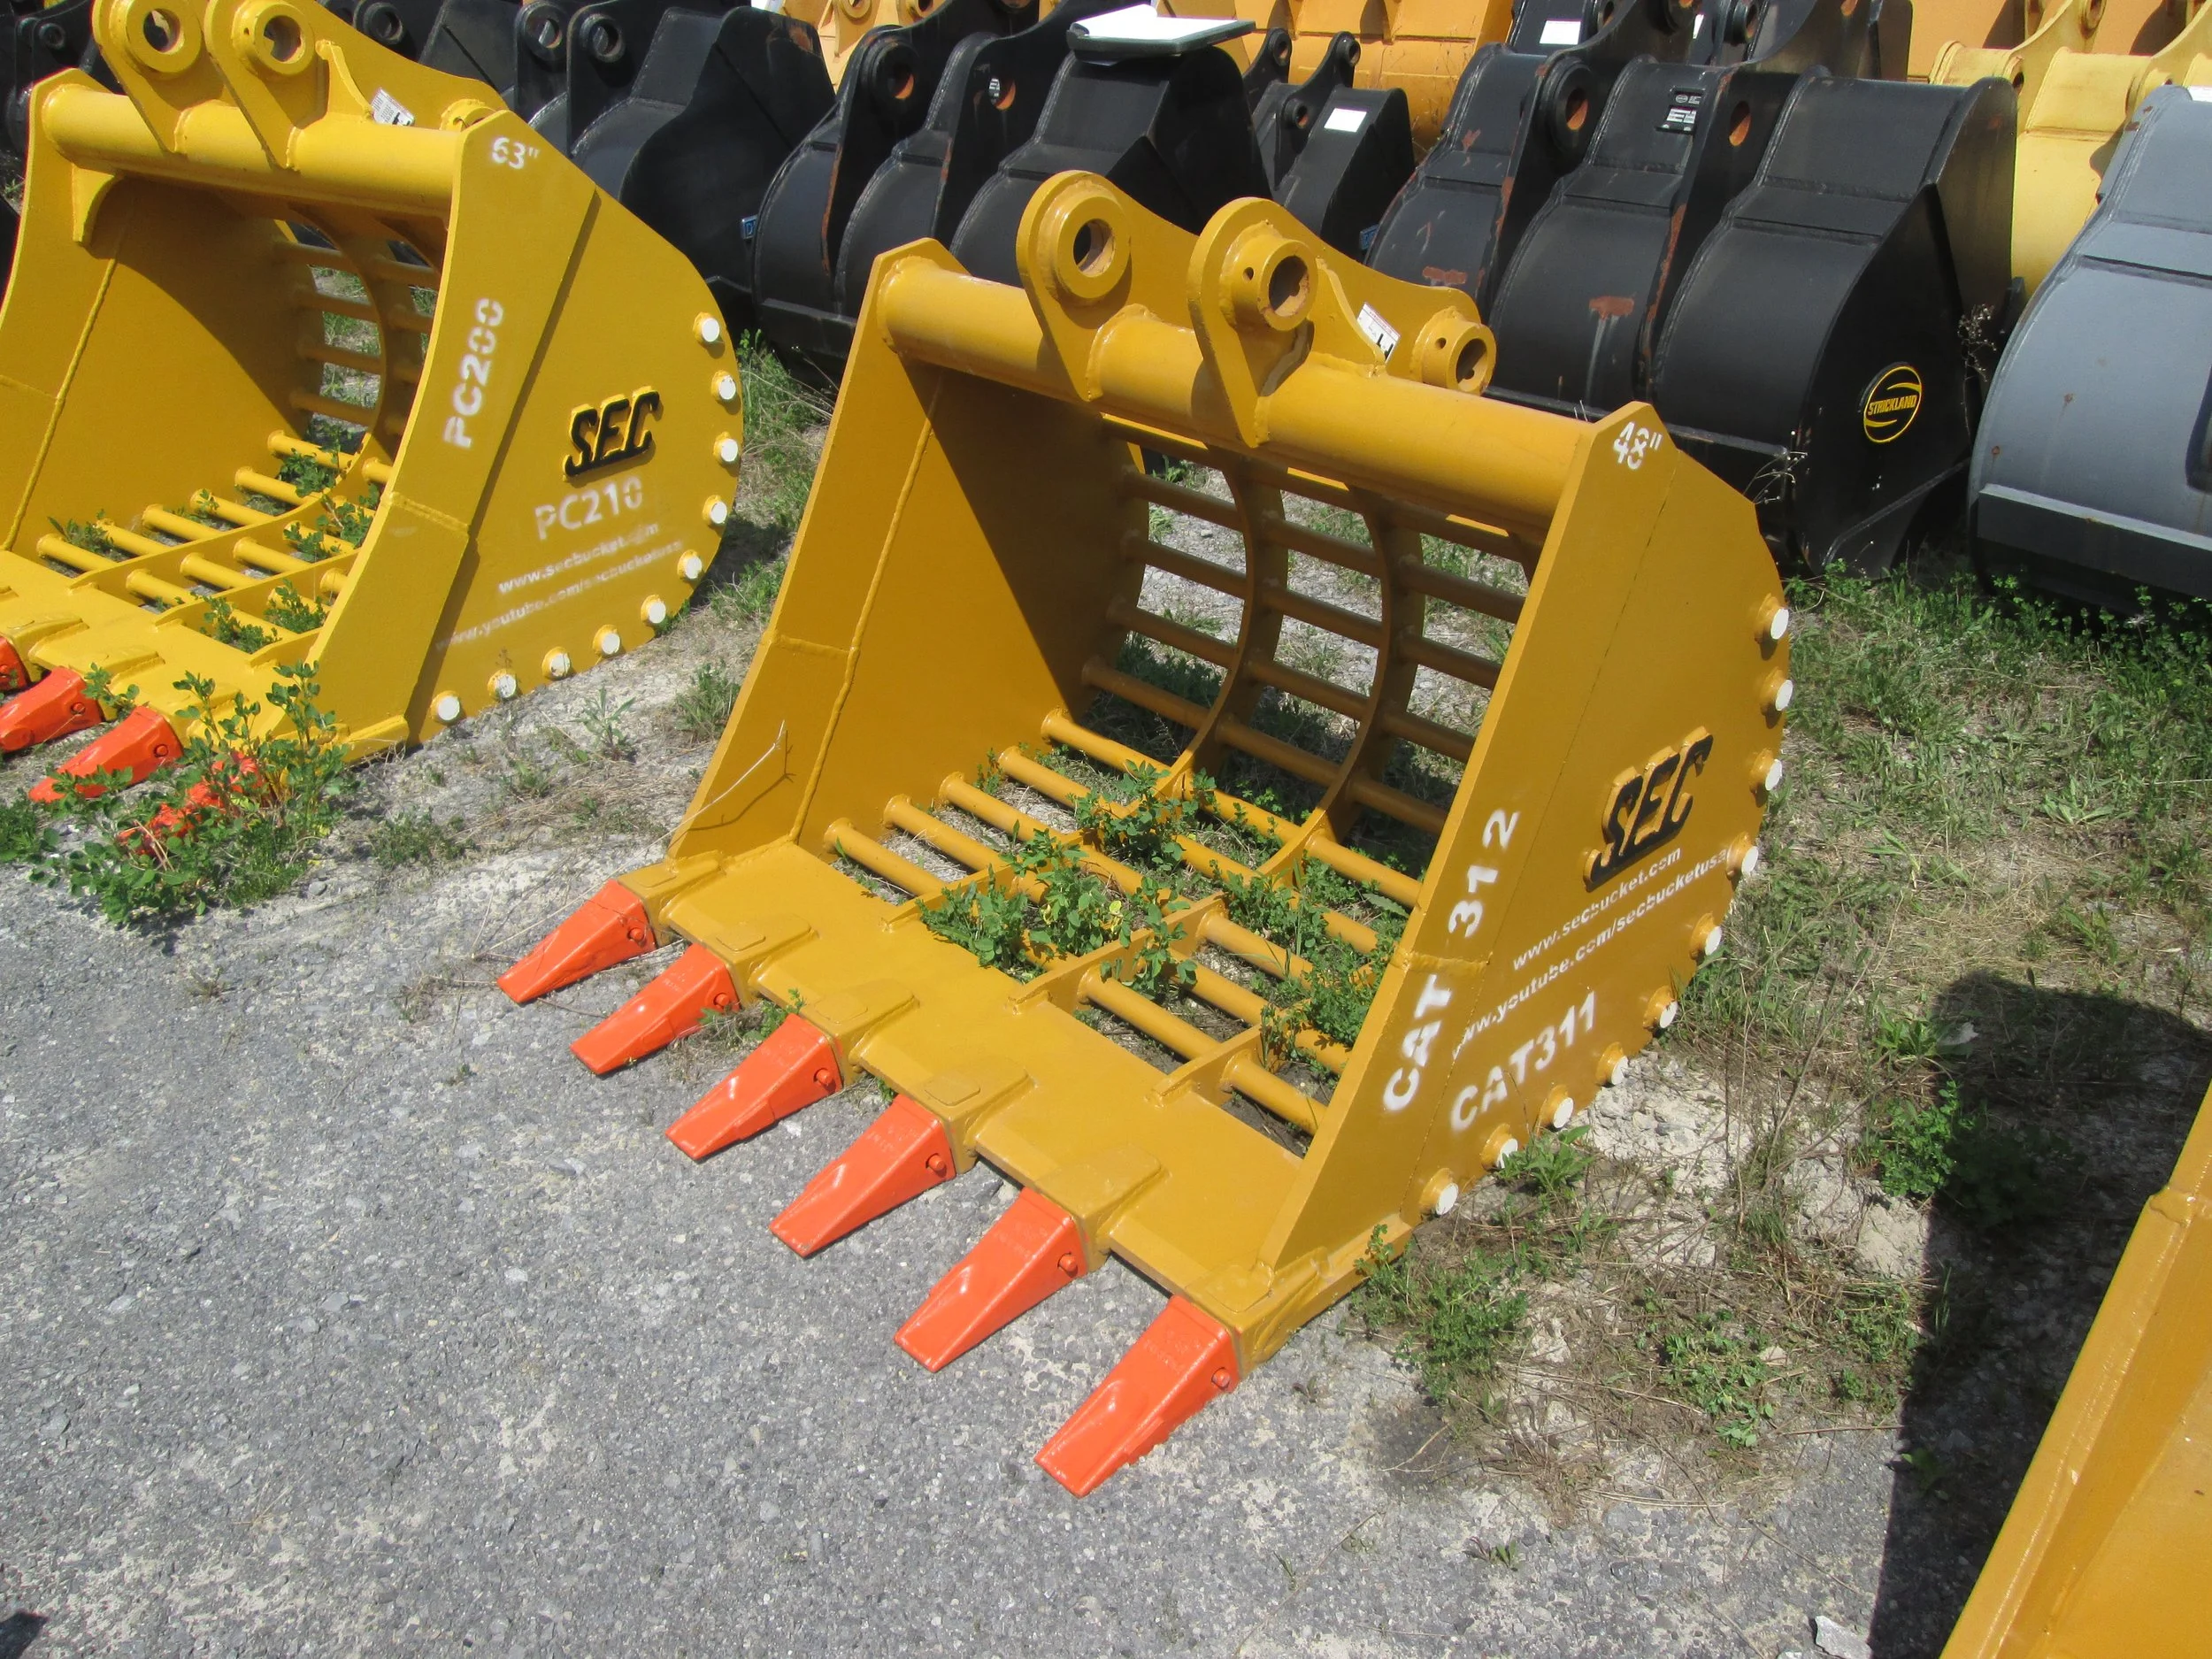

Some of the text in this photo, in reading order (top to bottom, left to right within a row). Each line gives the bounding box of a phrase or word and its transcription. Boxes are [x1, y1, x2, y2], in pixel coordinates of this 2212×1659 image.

[492, 136, 539, 170] 63"
[443, 297, 505, 449] PC200
[1867, 395, 1917, 416] STRICKLAND
[563, 387, 658, 479] SEC
[1613, 421, 1663, 470] 48"
[534, 476, 643, 541] PC210
[1584, 726, 1714, 892] SEC
[1382, 808, 1521, 1112] CAT 312
[1512, 847, 1682, 972] www.secbucket.com
[1449, 990, 1596, 1133] CAT311
